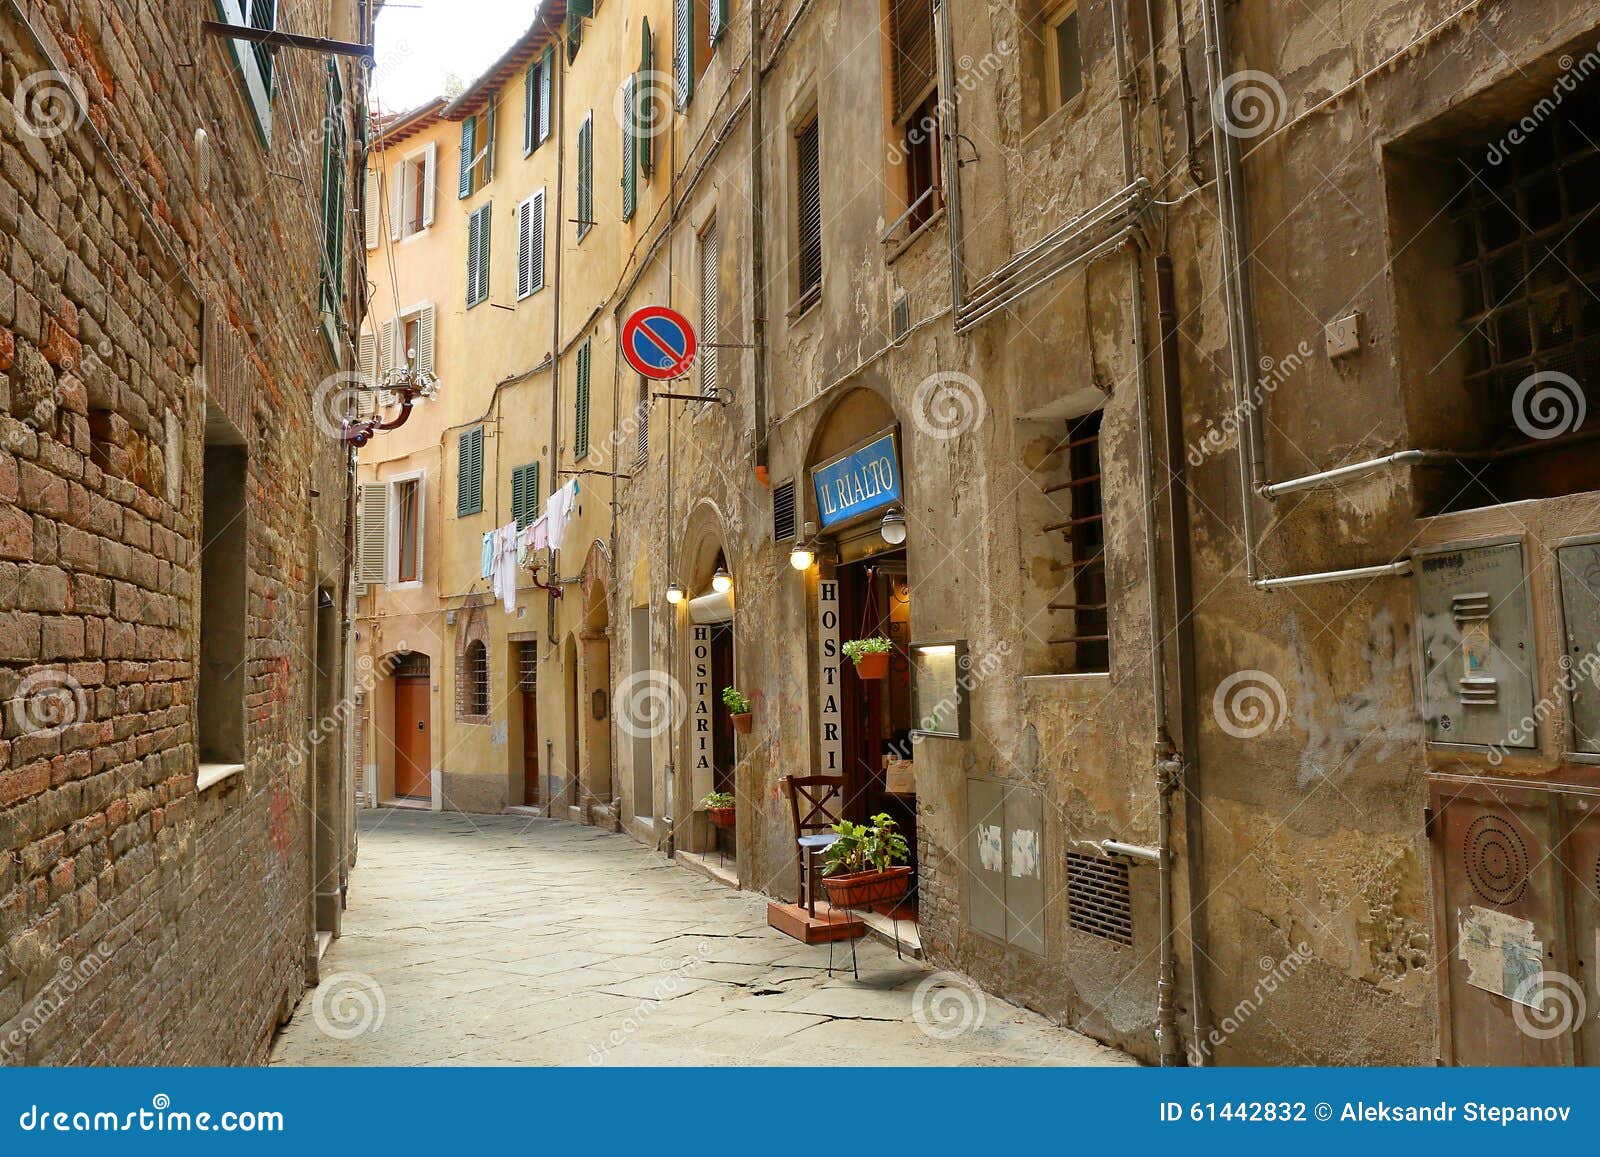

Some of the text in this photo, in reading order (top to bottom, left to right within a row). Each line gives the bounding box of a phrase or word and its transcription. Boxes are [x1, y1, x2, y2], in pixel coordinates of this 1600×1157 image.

[821, 456, 894, 515] IL RIALTO
[694, 627, 710, 769] HOSTARIA
